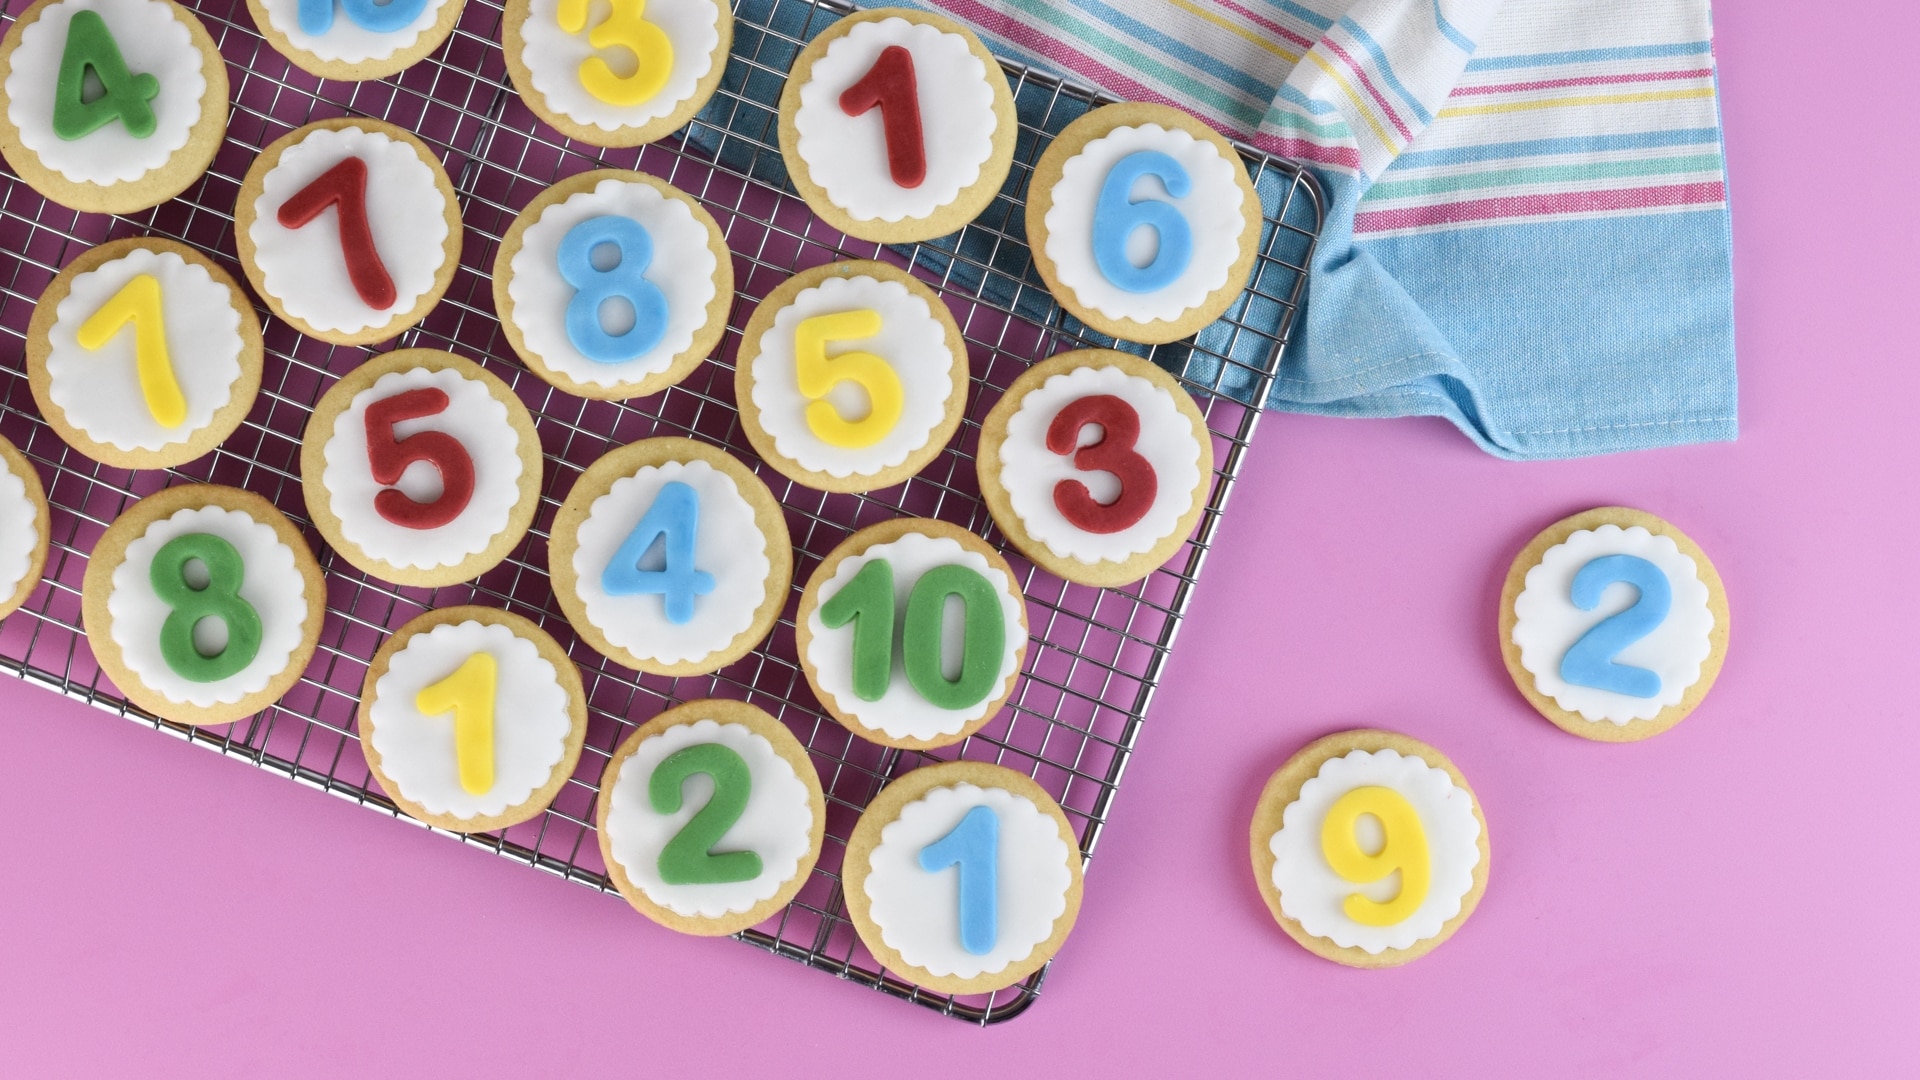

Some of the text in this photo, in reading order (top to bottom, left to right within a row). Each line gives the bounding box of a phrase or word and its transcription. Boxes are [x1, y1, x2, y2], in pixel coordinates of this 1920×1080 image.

[53, 11, 159, 139] 4
[557, 0, 673, 106] 3
[838, 46, 927, 190] 1
[277, 156, 397, 310] 7
[557, 215, 669, 363] 8
[1091, 151, 1193, 294] 6
[78, 275, 187, 427] 7
[796, 310, 904, 448] 5
[364, 387, 475, 529] 5
[1046, 394, 1157, 534] 3
[150, 533, 263, 681] 8
[601, 481, 715, 625] 4
[820, 559, 1004, 709] 10
[1560, 554, 1672, 698] 2
[416, 653, 495, 795] 1
[649, 743, 762, 884] 2
[919, 805, 999, 956] 1
[1321, 786, 1430, 926] 9
